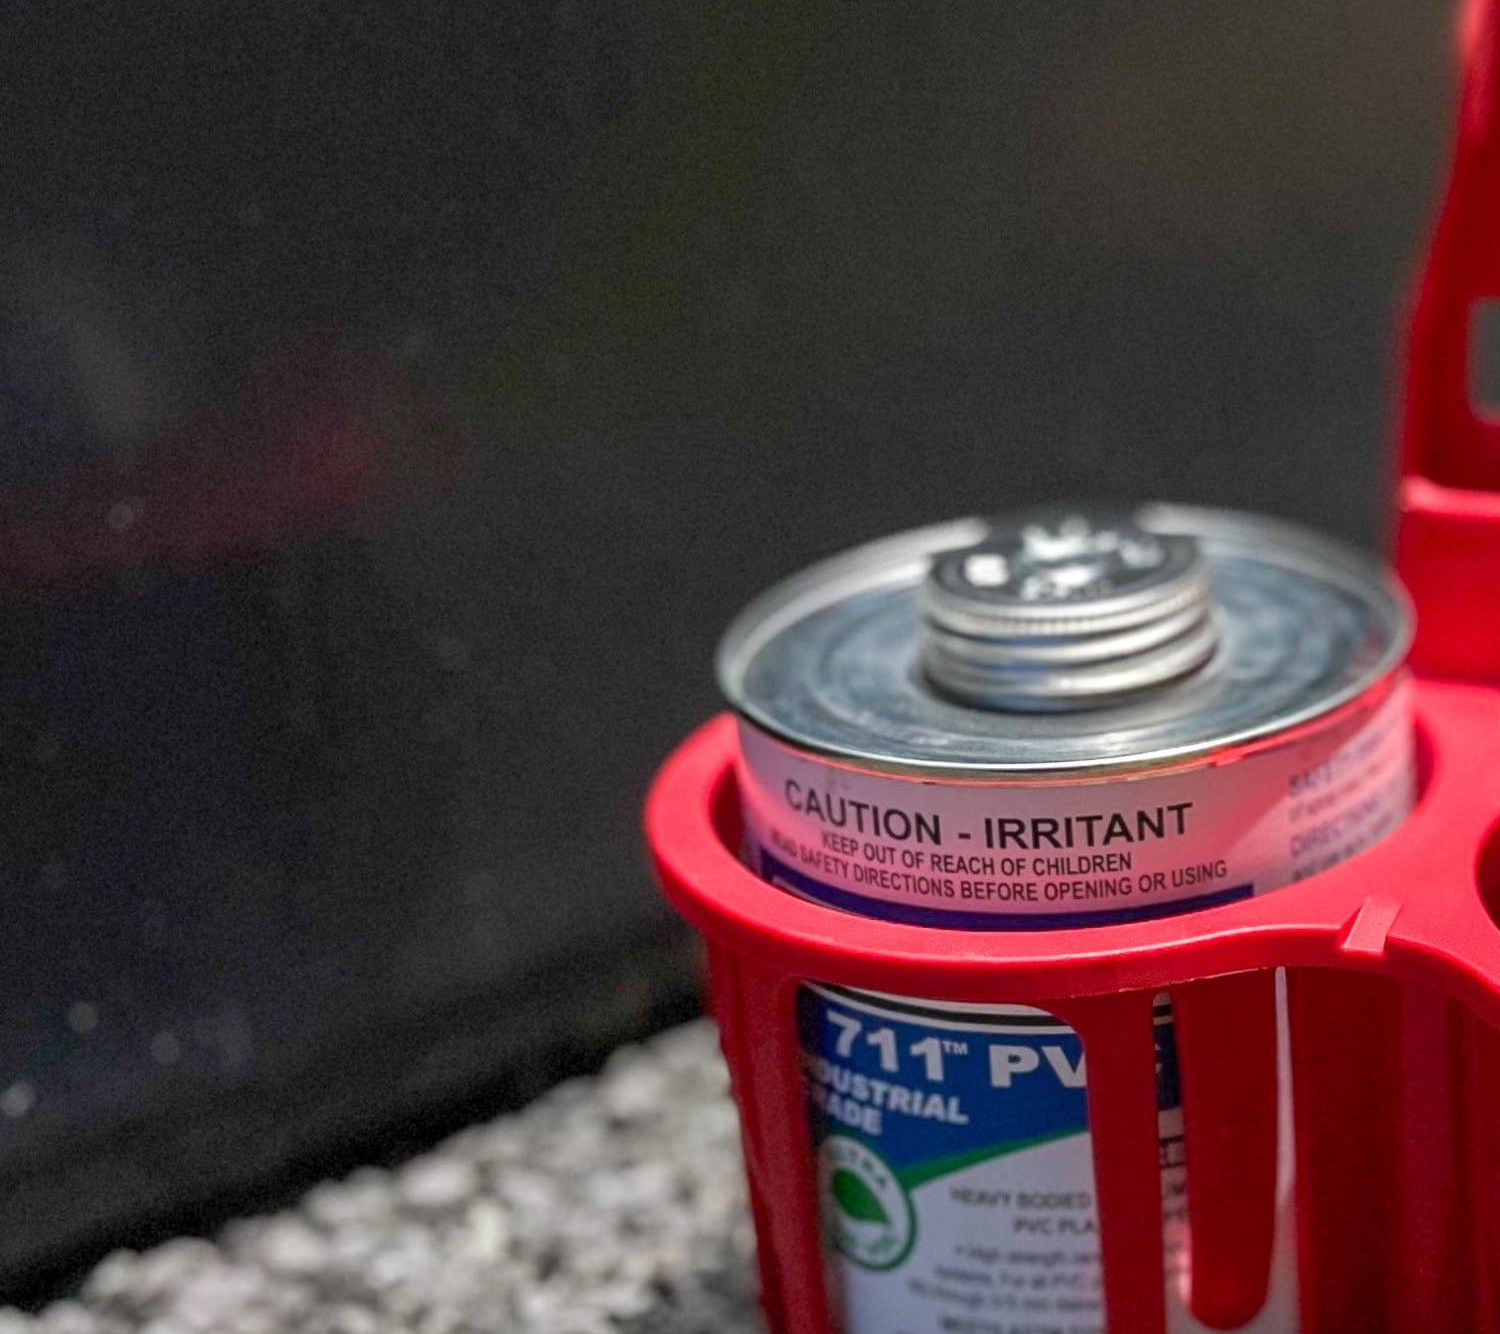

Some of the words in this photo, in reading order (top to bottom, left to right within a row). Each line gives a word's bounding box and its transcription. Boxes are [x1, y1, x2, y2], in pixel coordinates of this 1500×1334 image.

[784, 778, 942, 846] CAUTION
[984, 802, 1194, 850] IRRITANT
[800, 844, 850, 879] SAFETY
[853, 863, 956, 899] DIRECTIONS
[960, 880, 1039, 902] BEFORE
[1050, 877, 1133, 902] OPENING
[1138, 872, 1167, 894] OR
[1171, 859, 1228, 888] USING
[822, 829, 859, 857] KEEP
[863, 842, 897, 865] OUT
[901, 849, 926, 869] OF
[931, 854, 995, 876] REACH
[1000, 857, 1026, 877] OF
[1032, 851, 1132, 877] CHILDREN
